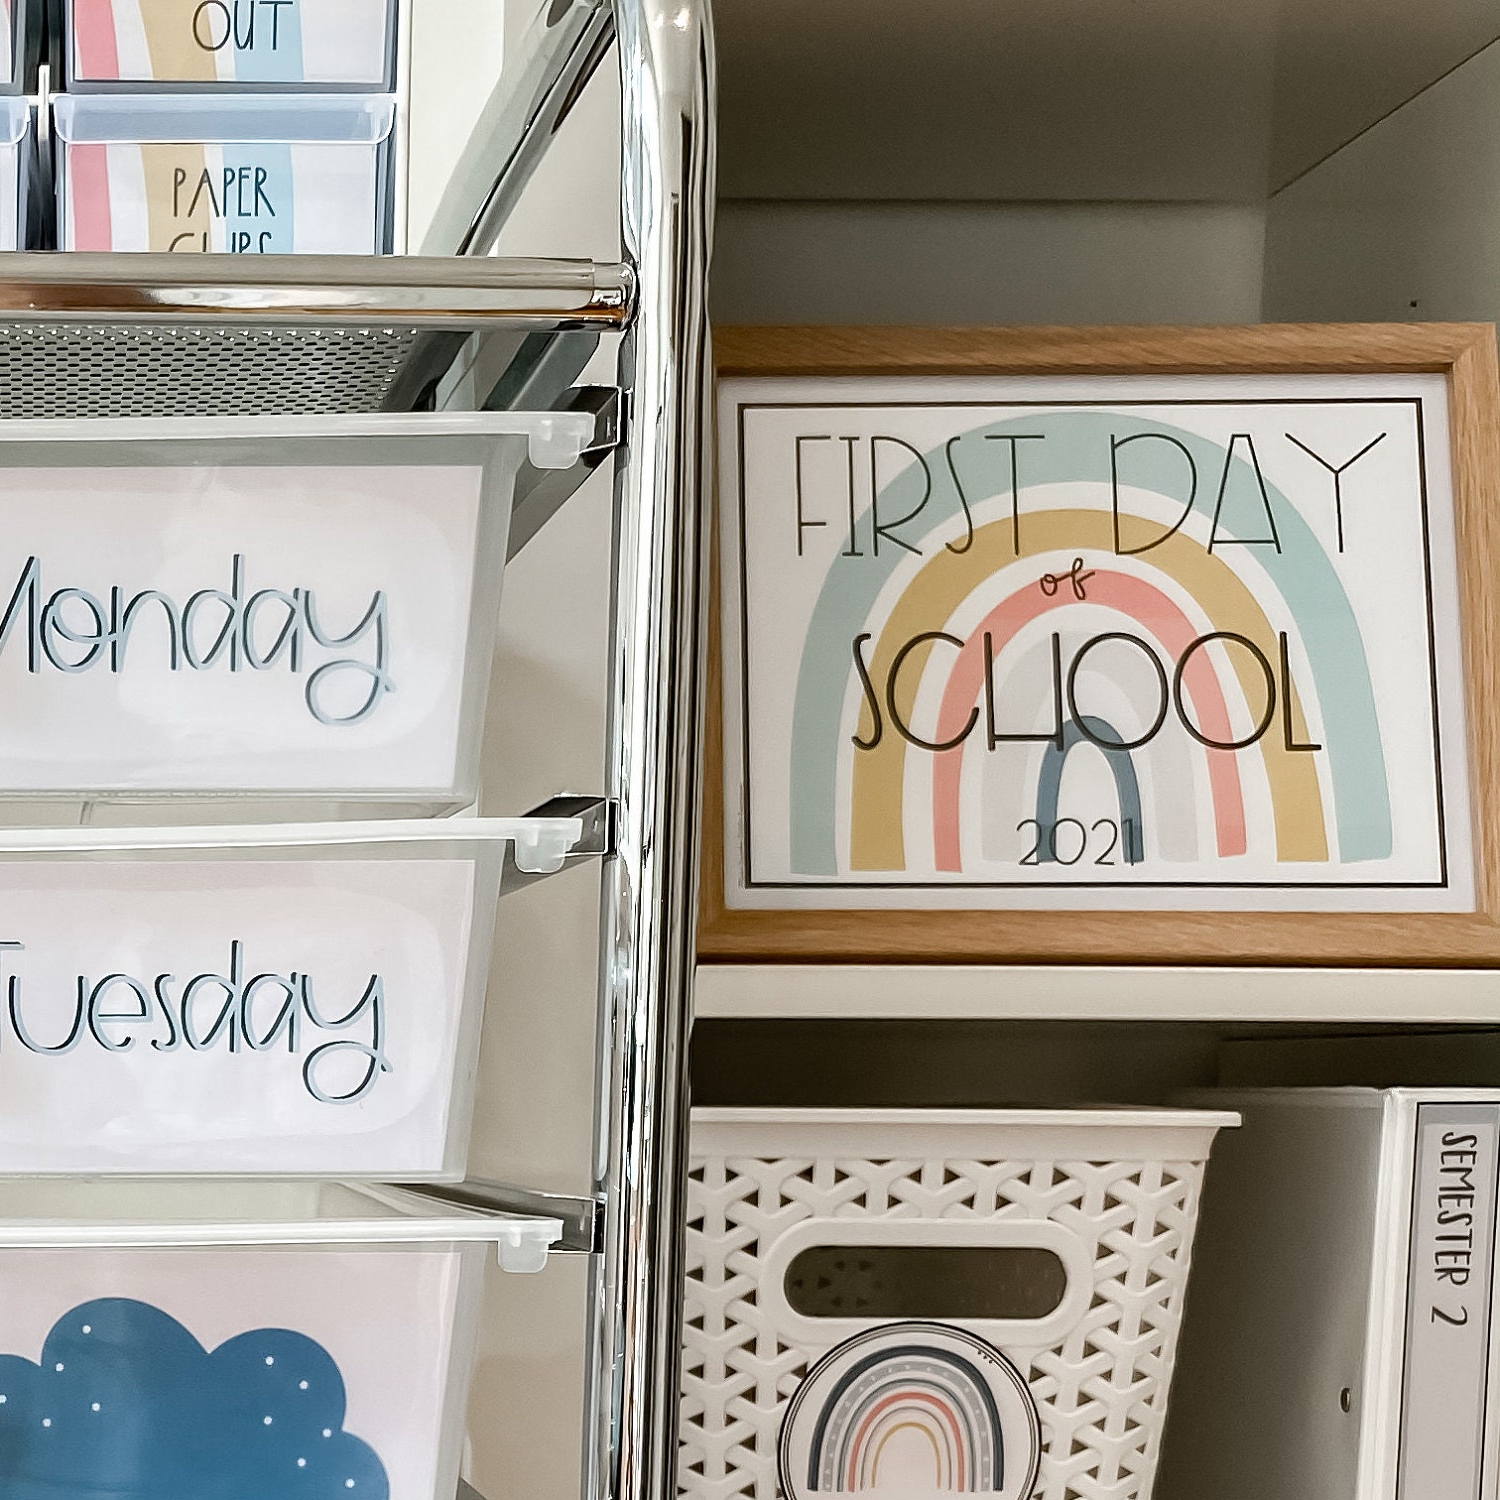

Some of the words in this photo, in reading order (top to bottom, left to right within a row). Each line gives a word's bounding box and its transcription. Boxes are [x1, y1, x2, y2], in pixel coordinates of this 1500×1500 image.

[192, 0, 294, 51] OUT
[173, 166, 276, 218] PAPER
[795, 433, 1046, 557] FIRST
[1109, 431, 1387, 556] DAY
[1039, 557, 1097, 601] of
[851, 631, 1323, 753] SCHOOL
[1016, 817, 1136, 867] 2021
[1433, 1131, 1478, 1287] SEMESTER
[1430, 1304, 1469, 1327] 2
